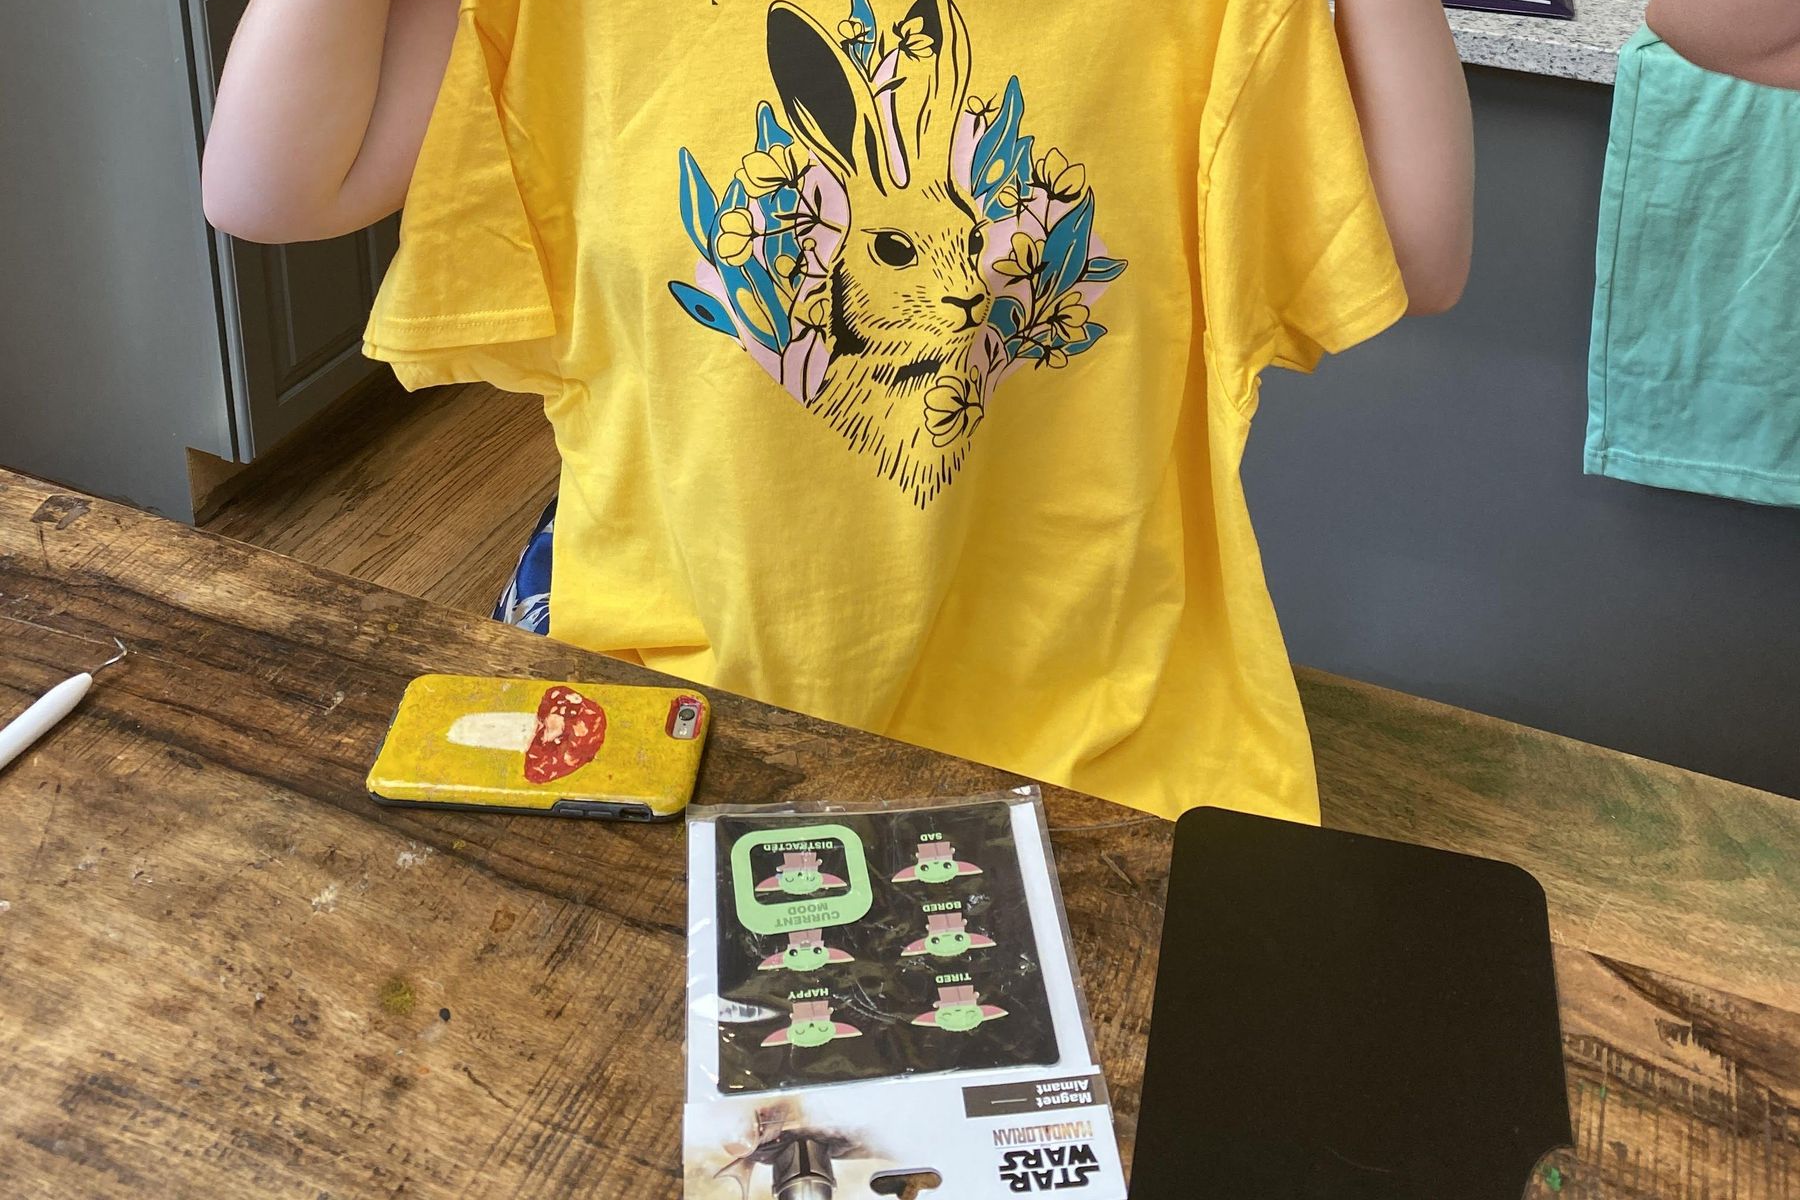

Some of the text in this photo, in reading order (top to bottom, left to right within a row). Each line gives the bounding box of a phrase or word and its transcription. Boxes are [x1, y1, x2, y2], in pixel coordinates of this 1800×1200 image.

[919, 832, 944, 843] SAD
[763, 840, 834, 853] DISTRACTED
[786, 903, 830, 917] MOOD
[921, 900, 963, 913] BORED
[773, 910, 841, 927] CURRENT
[934, 971, 972, 985] TIRED
[787, 987, 830, 1000] HAPPY
[1035, 1079, 1089, 1095] Aimant
[1035, 1091, 1093, 1108] Magnet
[992, 1121, 1094, 1146] MANDALORIAN
[998, 1144, 1098, 1172] WARS
[999, 1166, 1101, 1194] STAR
